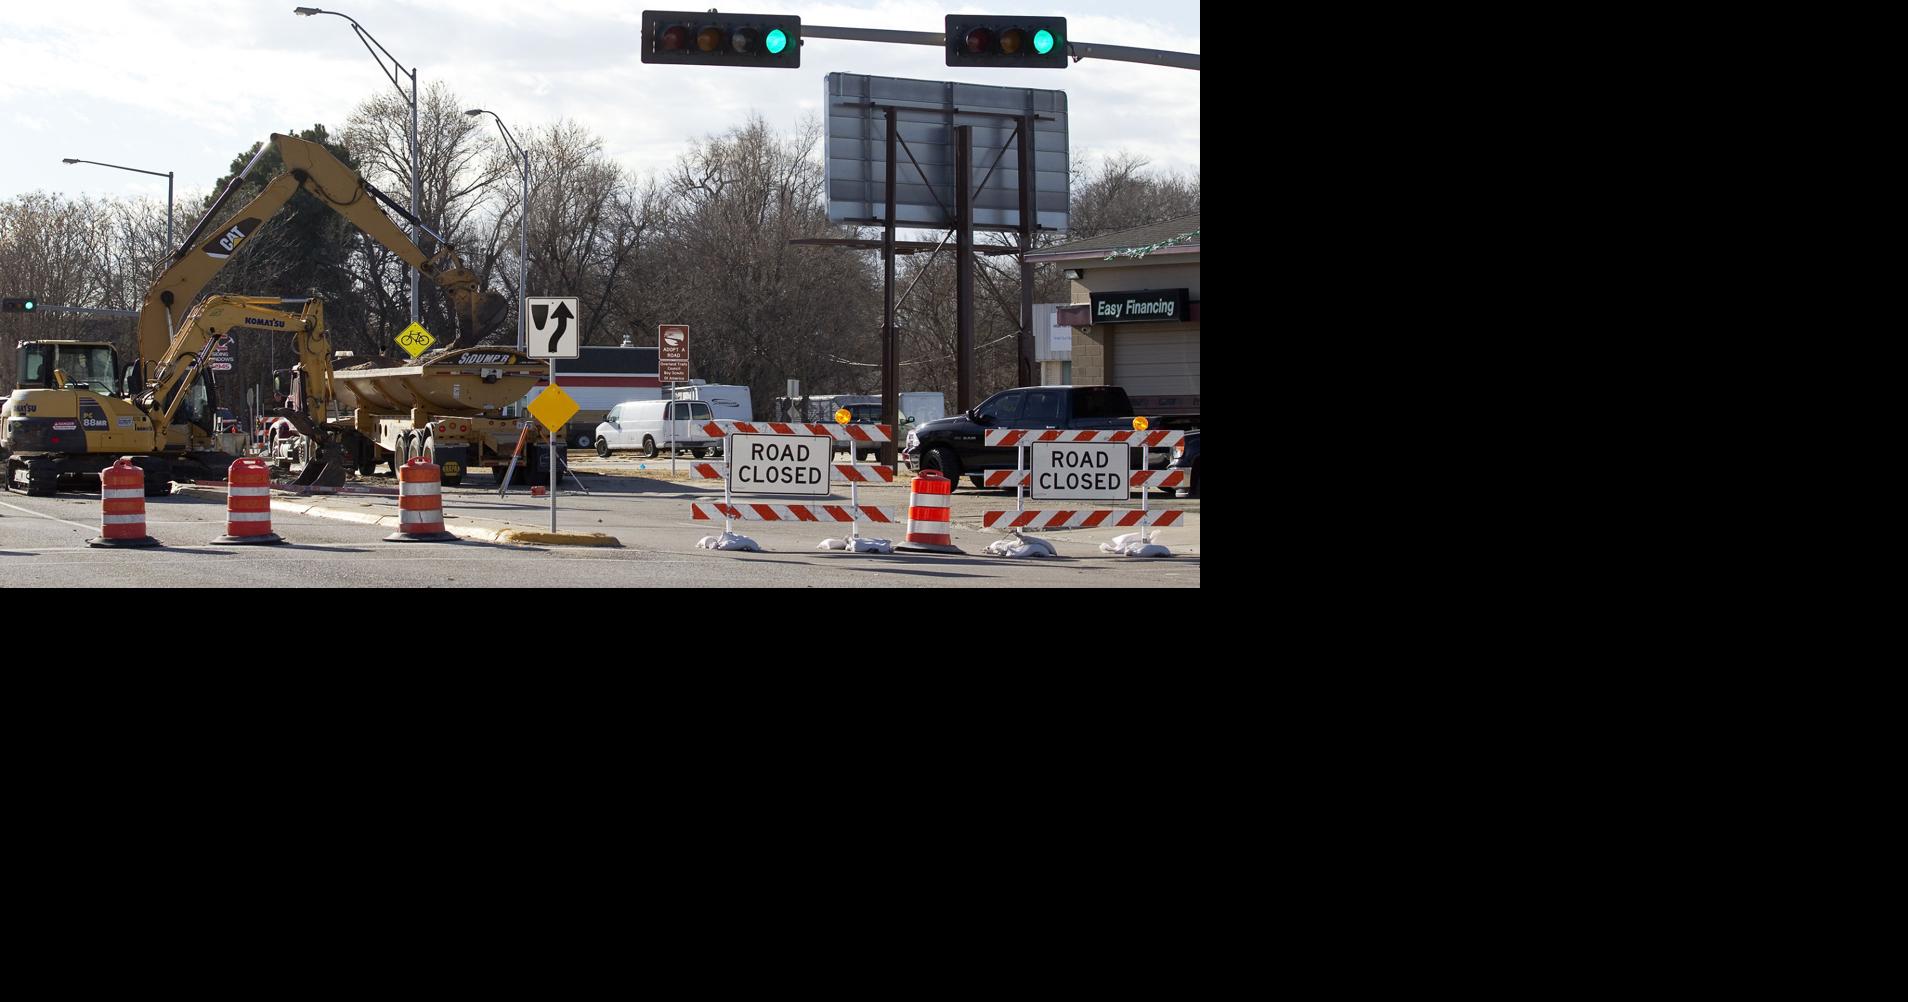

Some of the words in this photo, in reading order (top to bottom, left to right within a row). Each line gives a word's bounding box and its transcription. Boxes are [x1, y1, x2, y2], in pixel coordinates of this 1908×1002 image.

[220, 225, 246, 251] CAT
[1098, 300, 1122, 317] Easy
[1126, 298, 1174, 316] Financing
[245, 317, 285, 327] KOMATSU
[751, 443, 810, 461] ROAD
[1052, 451, 1109, 468] ROAD
[738, 465, 822, 484] CLOSED
[1040, 472, 1120, 490] CLOSED
